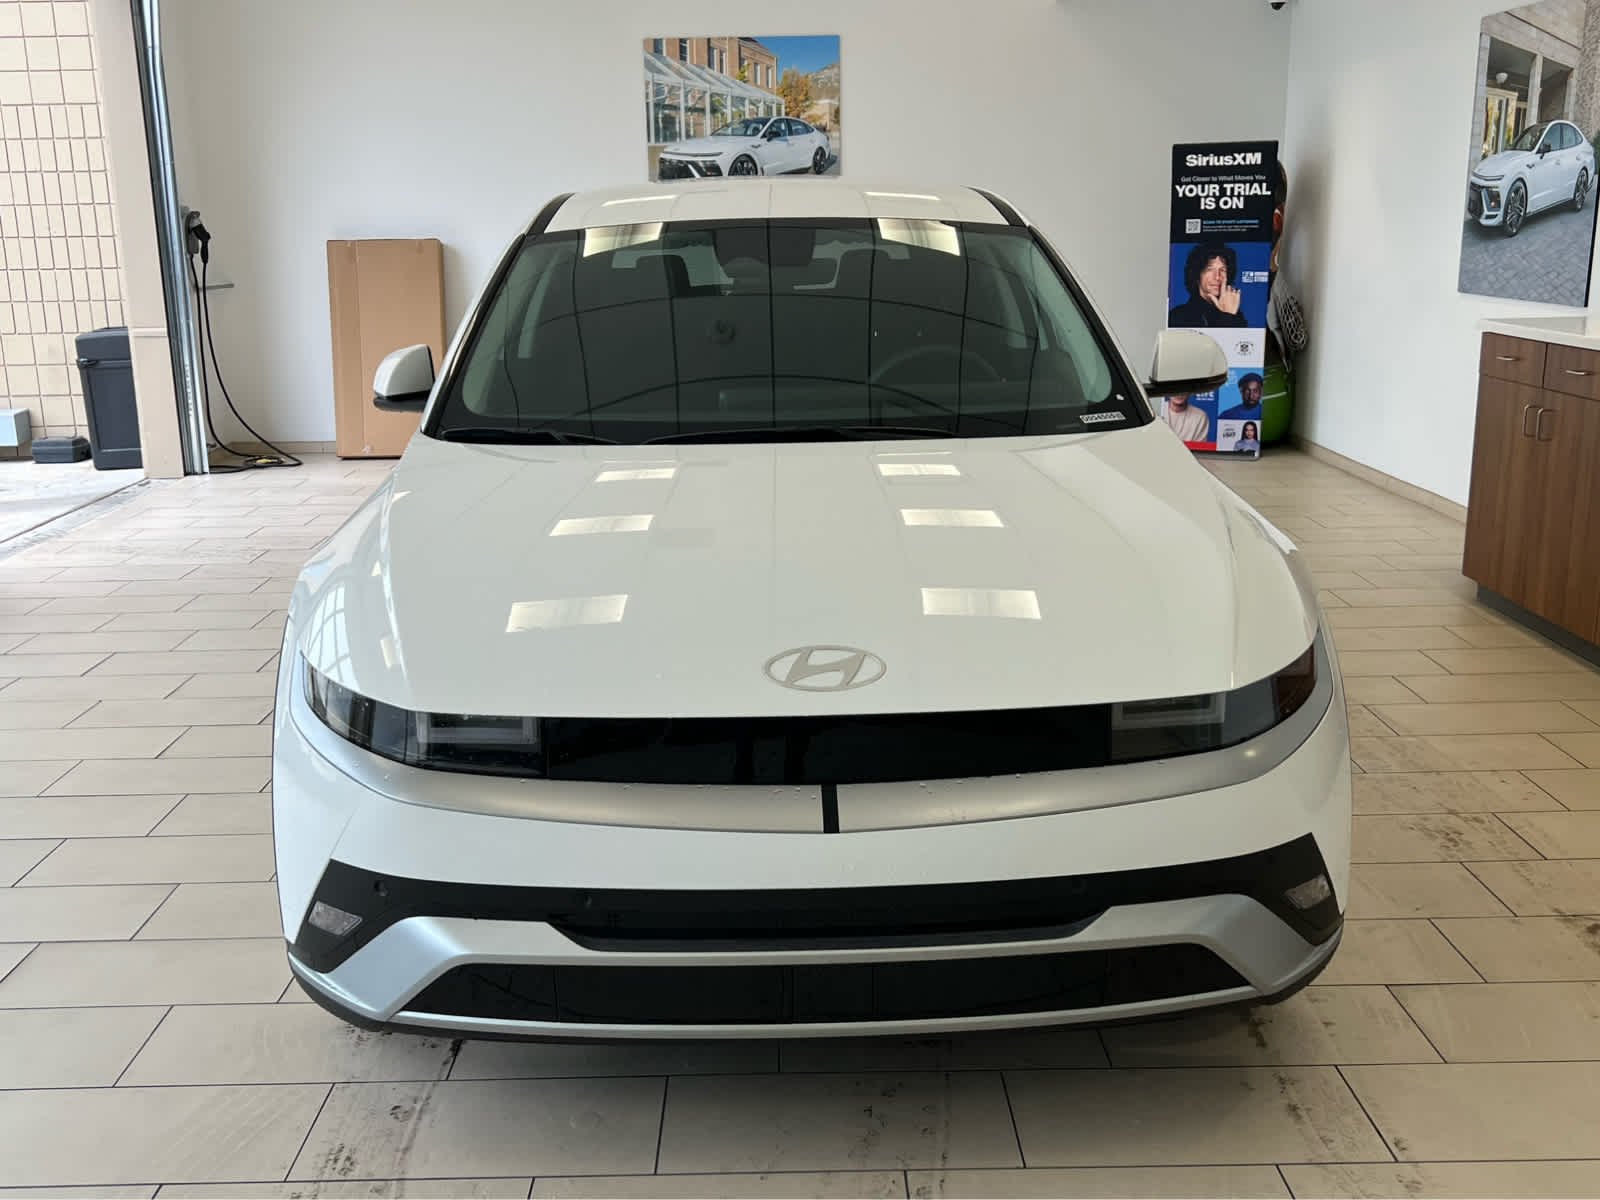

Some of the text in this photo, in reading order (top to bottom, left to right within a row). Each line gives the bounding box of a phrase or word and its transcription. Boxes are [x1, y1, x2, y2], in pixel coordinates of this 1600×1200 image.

[1185, 152, 1262, 167] SiriusXM
[1175, 182, 1272, 198] YOUR TRIAL
[1200, 196, 1245, 210] IS ON
